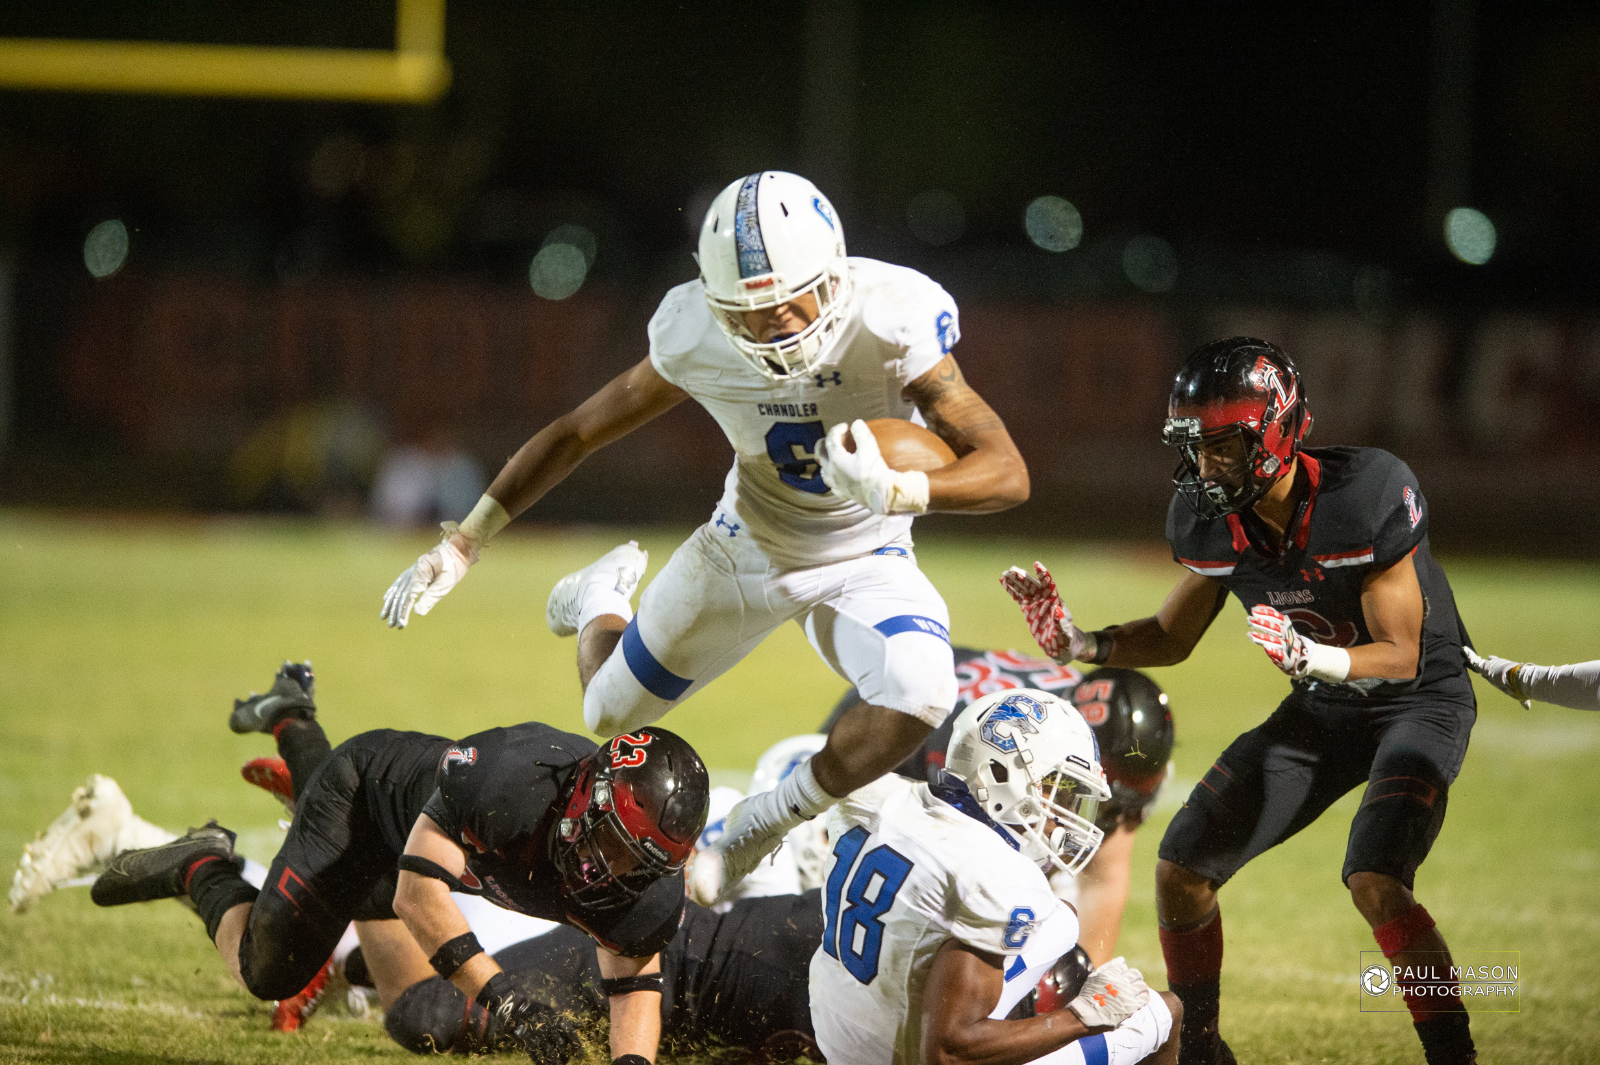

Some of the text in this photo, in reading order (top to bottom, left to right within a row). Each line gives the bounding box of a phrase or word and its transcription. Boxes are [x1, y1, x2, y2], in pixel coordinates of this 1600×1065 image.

[757, 403, 819, 417] CHANDLER
[1266, 589, 1315, 605] LIONS
[611, 733, 653, 770] 23
[822, 824, 915, 986] 18
